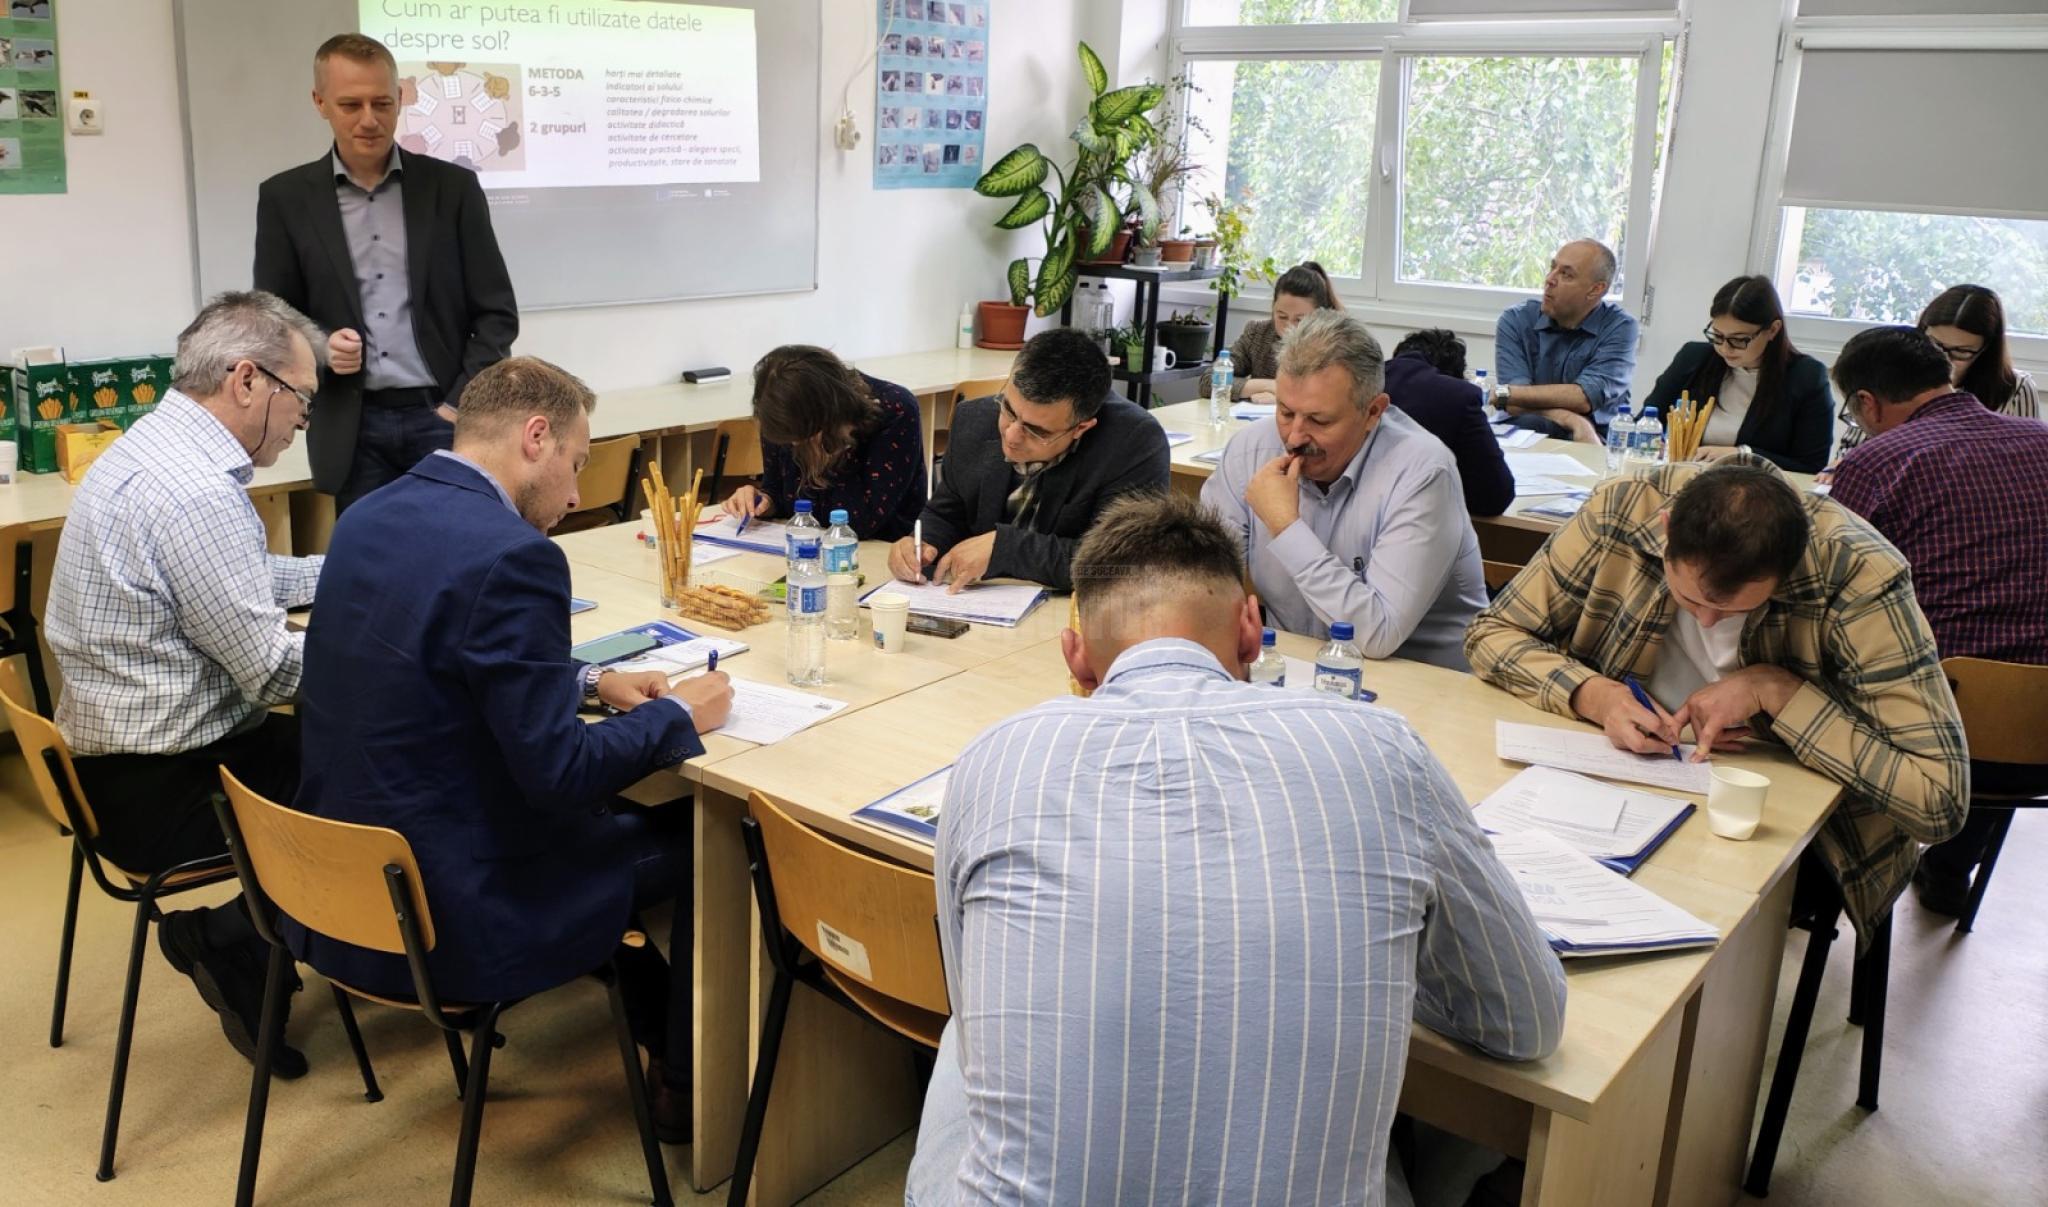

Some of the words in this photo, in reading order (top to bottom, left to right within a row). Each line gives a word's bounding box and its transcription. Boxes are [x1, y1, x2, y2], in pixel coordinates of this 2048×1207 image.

[383, 0, 441, 17] Cum
[450, 4, 472, 20] ar
[481, 5, 542, 26] putea
[548, 5, 559, 24] fi
[567, 8, 641, 29] utilizate
[647, 11, 702, 31] datele
[384, 27, 464, 54] despre
[472, 30, 511, 51] sol?
[528, 68, 584, 80] METODA
[627, 71, 643, 79] mai
[646, 70, 682, 79] detaliate
[606, 82, 646, 91] indicatori
[657, 83, 683, 91] solului
[529, 86, 561, 97] 6-3-5
[606, 96, 660, 104] caracteristici
[607, 108, 643, 117] calitatea
[530, 122, 538, 133] 2
[541, 121, 586, 135] grupuri
[607, 120, 646, 129] activitate
[607, 133, 646, 142] activitate
[649, 133, 658, 142] de
[661, 133, 698, 142] cercetare
[608, 146, 647, 155] activitate
[688, 146, 717, 155] alegere
[671, 157, 690, 166] stare
[692, 157, 702, 166] de
